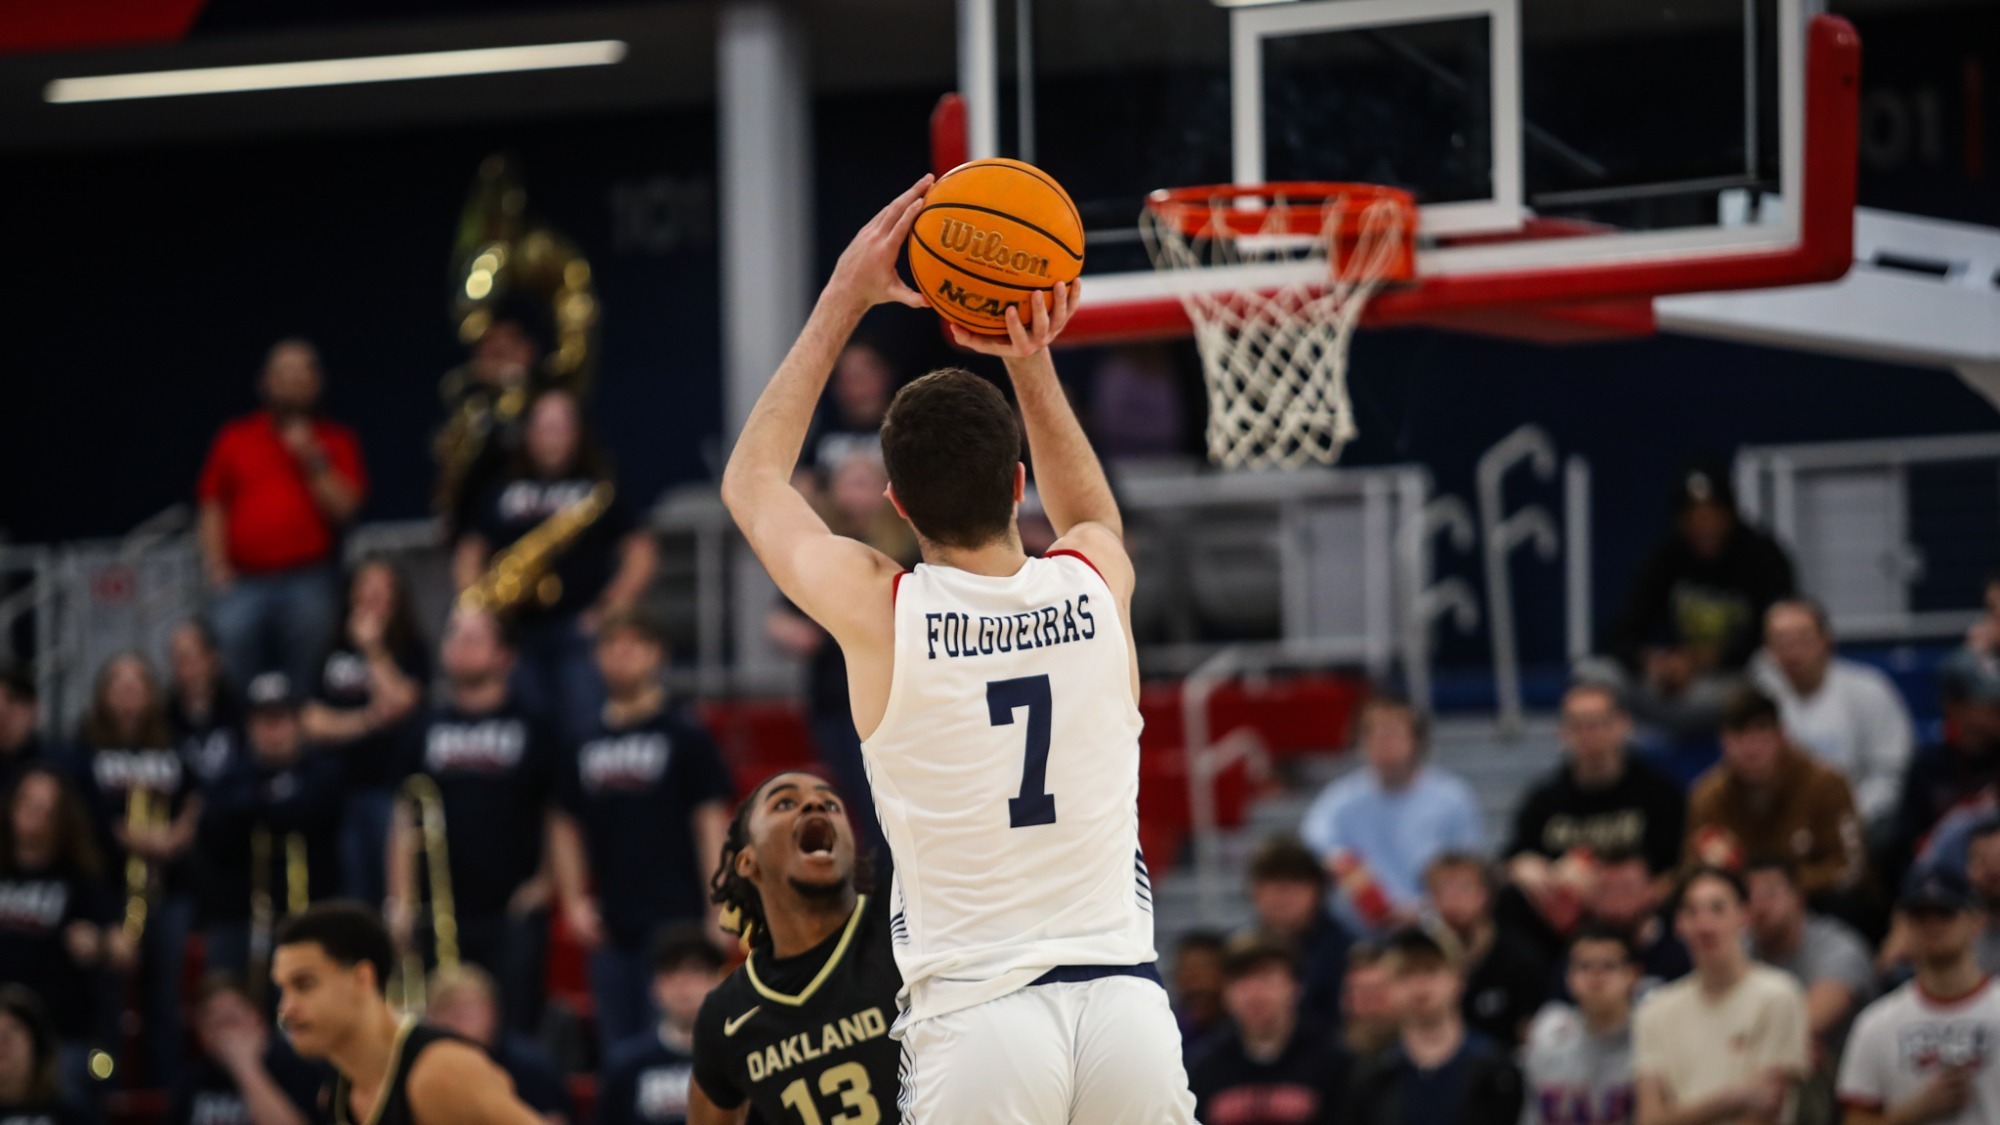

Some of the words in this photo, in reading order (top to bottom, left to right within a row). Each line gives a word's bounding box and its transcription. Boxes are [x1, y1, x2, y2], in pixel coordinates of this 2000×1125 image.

[940, 216, 1049, 278] Wilson
[925, 593, 1096, 660] FOLGUEIRAS
[986, 673, 1057, 829] 7
[746, 1006, 888, 1083] OAKLAND
[779, 1060, 882, 1125] 13
